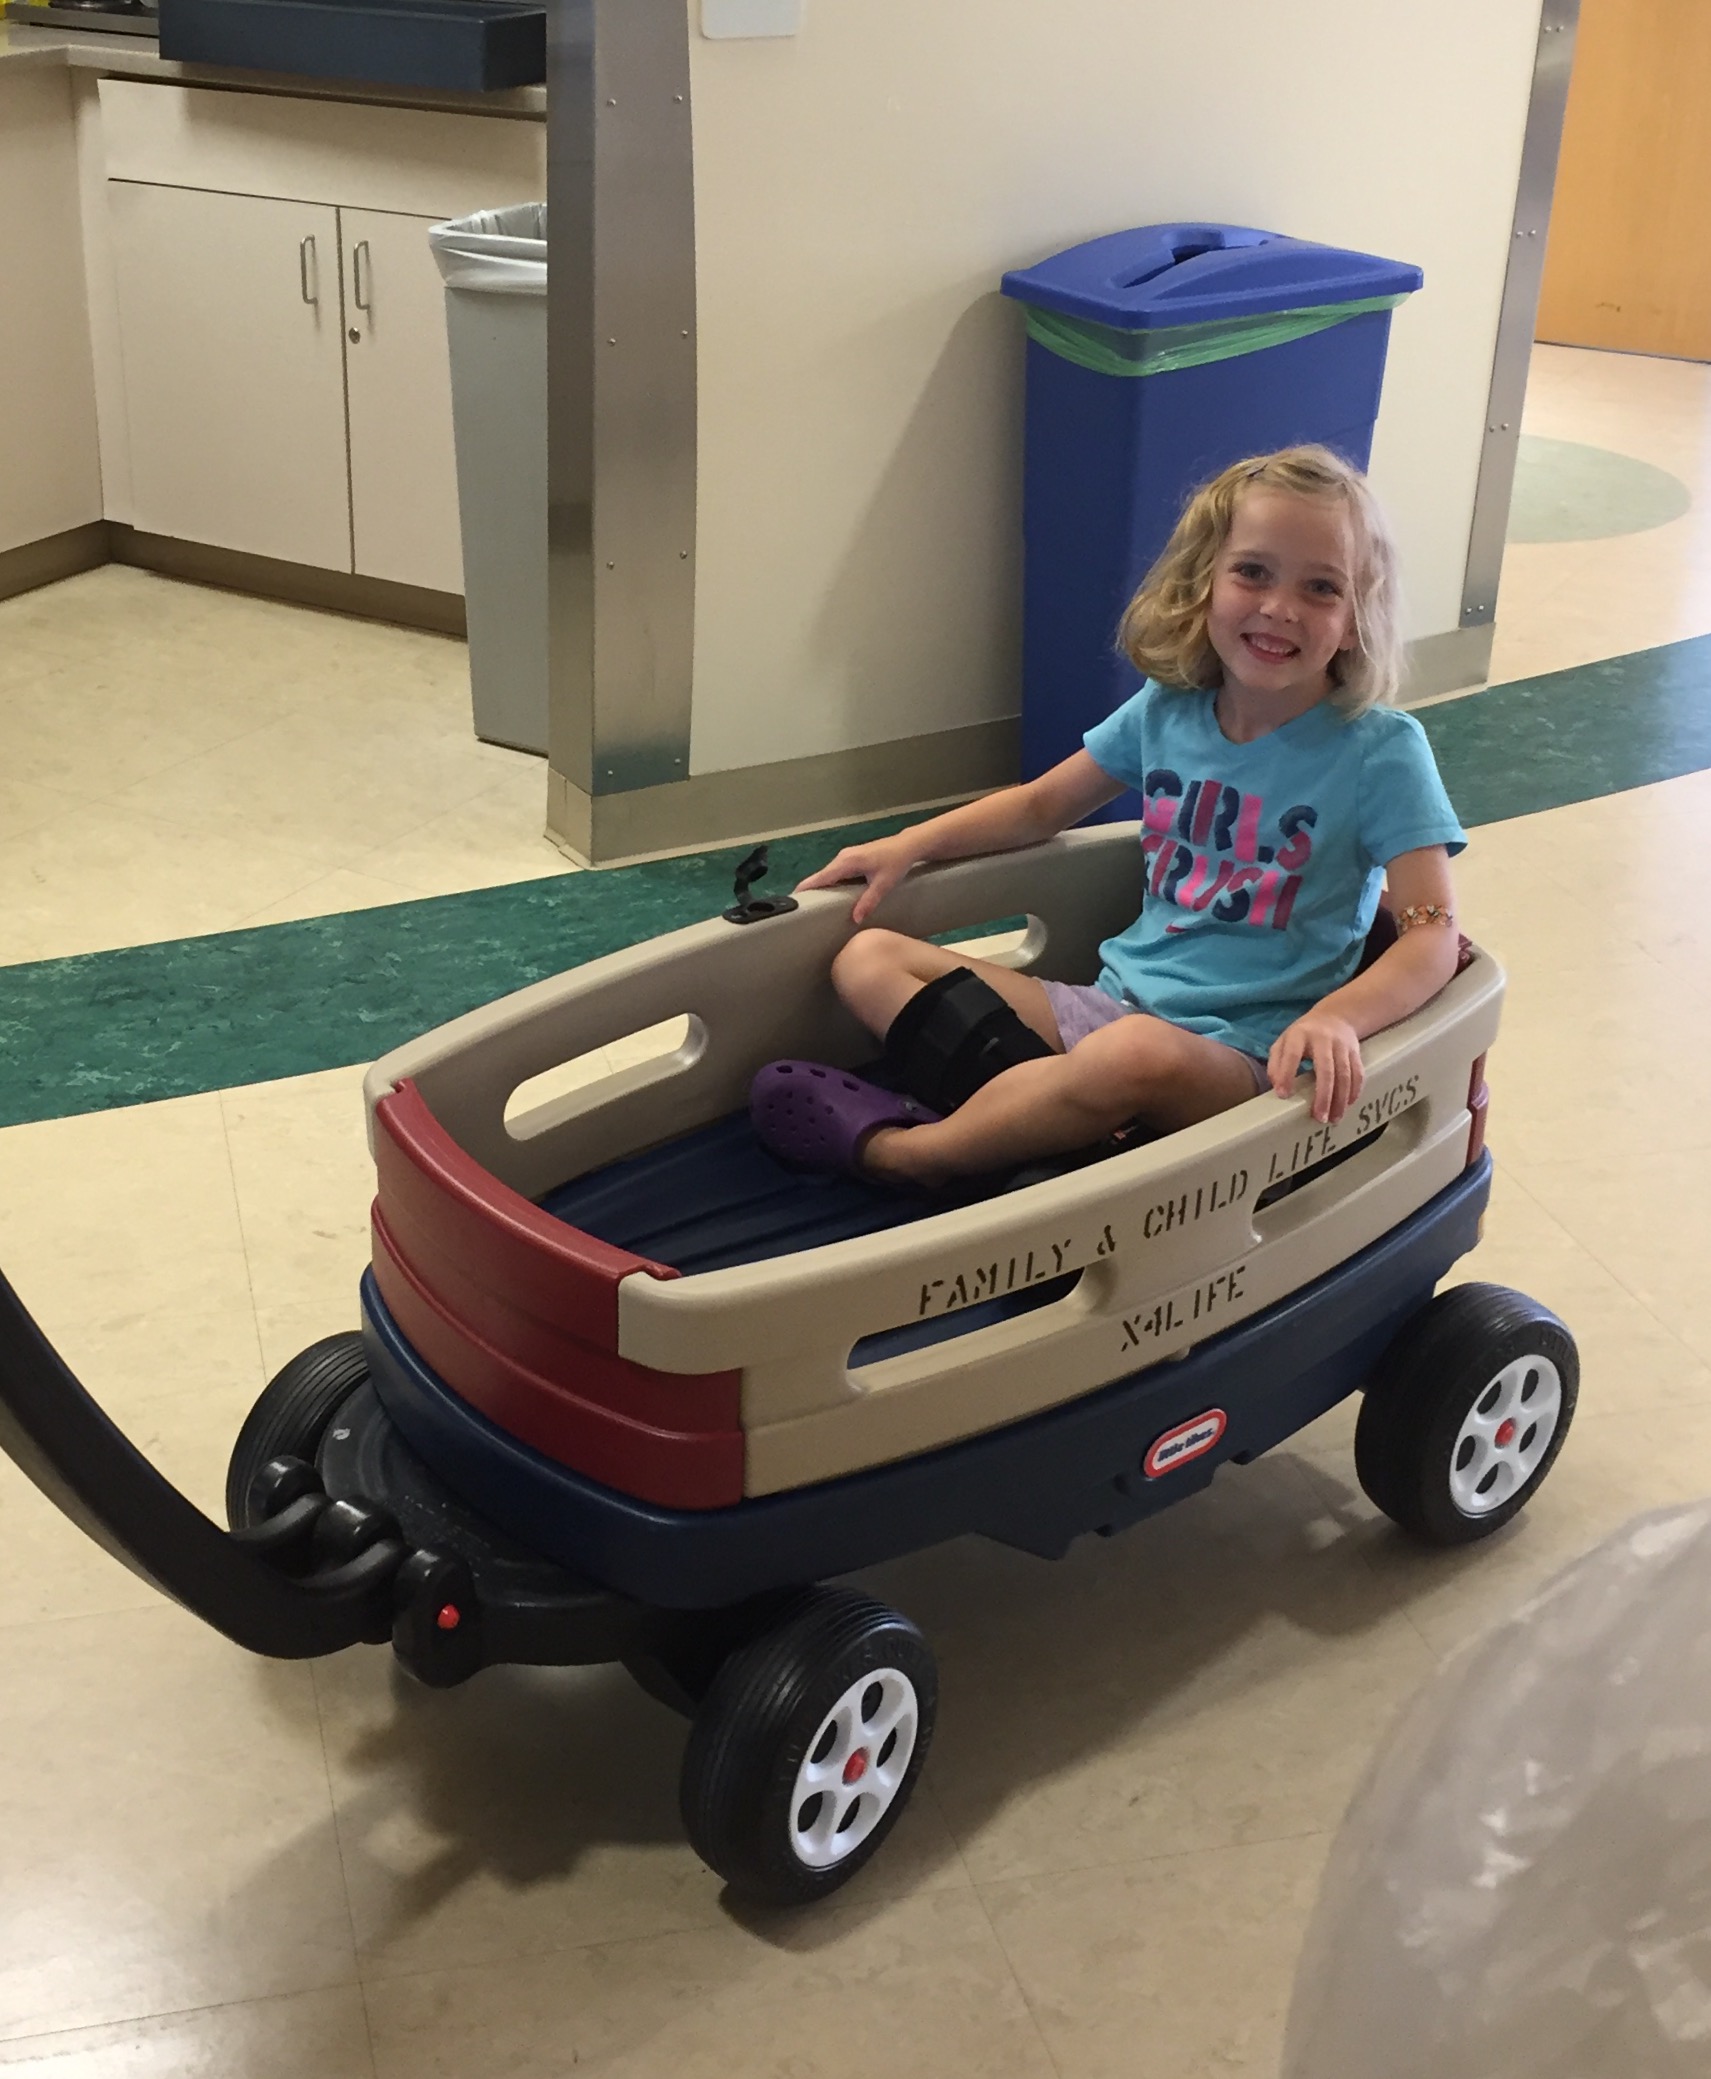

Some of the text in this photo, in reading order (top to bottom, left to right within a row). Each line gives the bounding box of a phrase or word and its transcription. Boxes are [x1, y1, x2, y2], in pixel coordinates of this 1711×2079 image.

[1143, 769, 1318, 871] GIRLS
[919, 1074, 1420, 1316] FAMILY & CHILD LIFE SVCS
